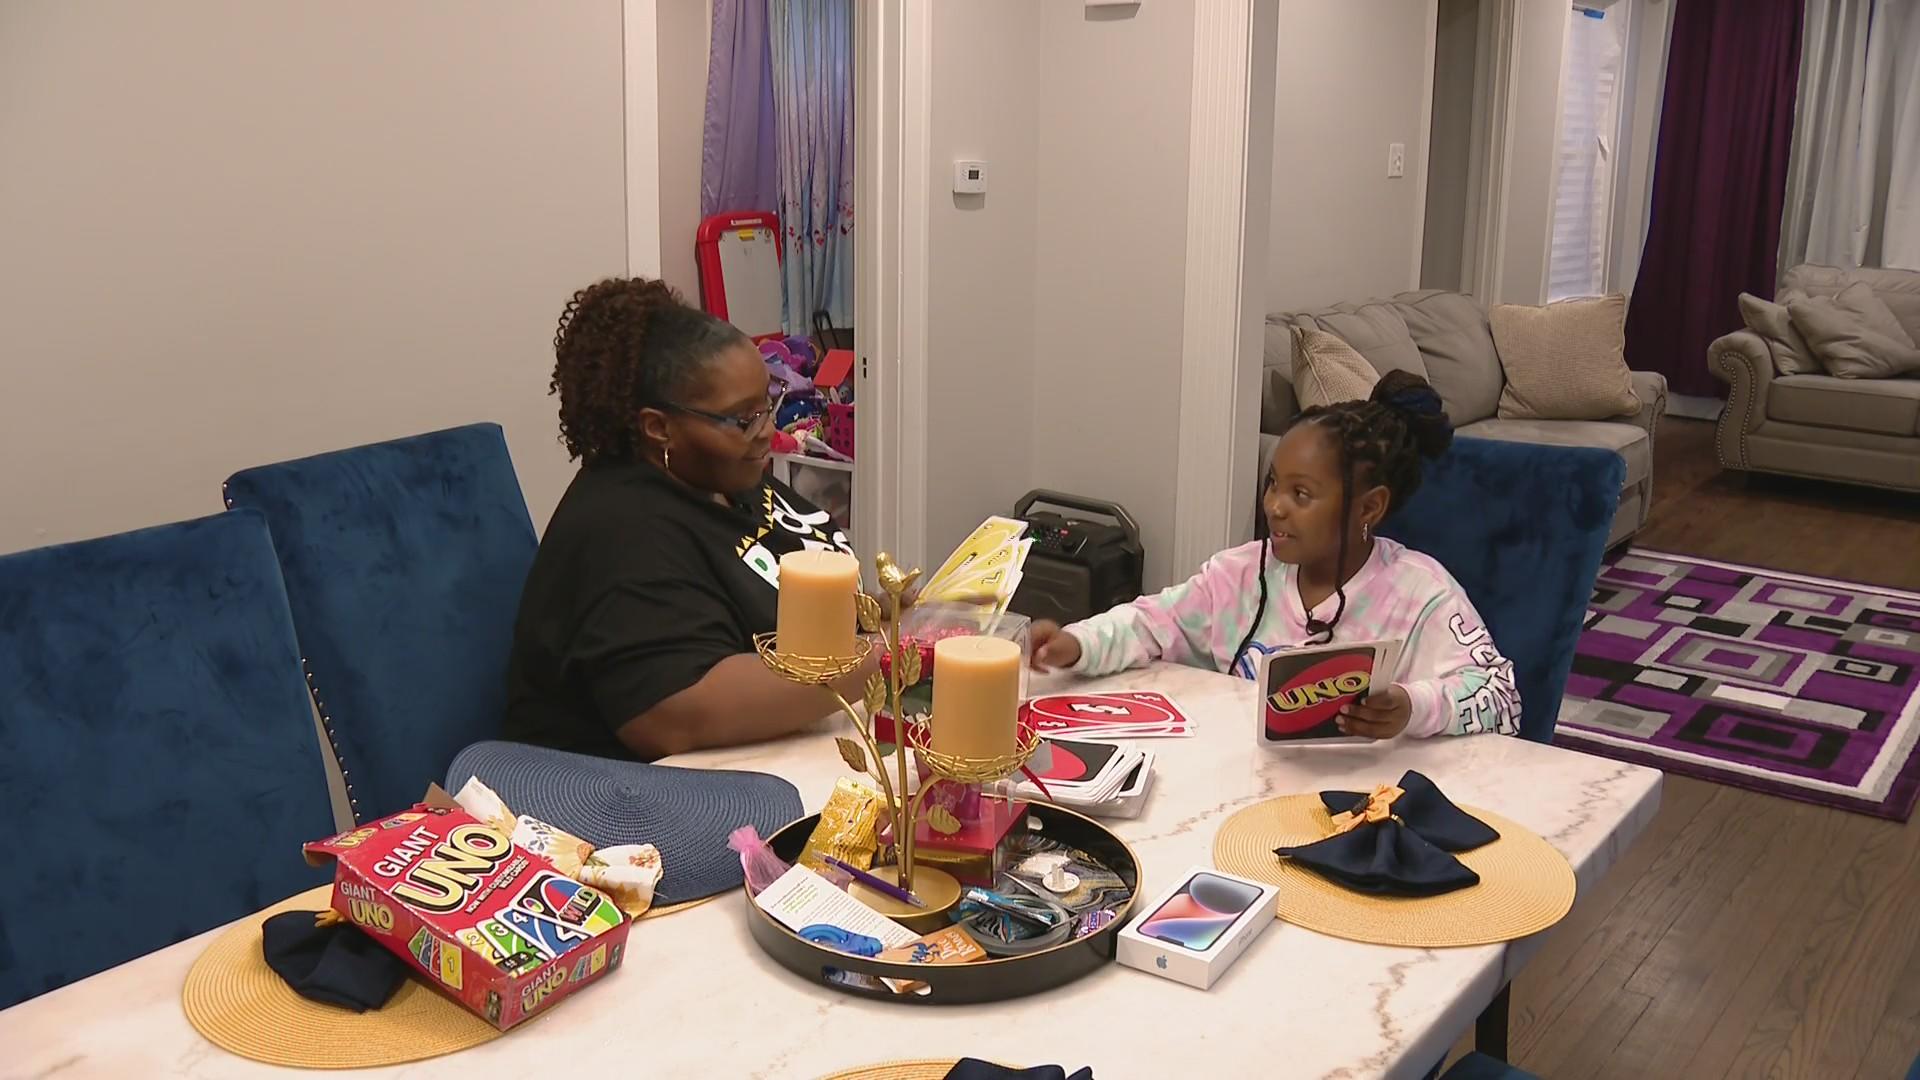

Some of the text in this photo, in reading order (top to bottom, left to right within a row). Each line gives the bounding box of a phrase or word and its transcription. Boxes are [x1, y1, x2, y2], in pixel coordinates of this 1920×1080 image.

[1266, 671, 1372, 714] UNO
[373, 824, 441, 878] GIANT
[389, 823, 513, 915] UNO
[340, 881, 378, 902] GIANT
[559, 886, 602, 926] WILD
[348, 897, 395, 931] UNO
[490, 923, 509, 937] 3
[512, 910, 529, 924] 4
[466, 933, 486, 947] 2
[447, 956, 455, 973] 1
[521, 962, 558, 998] GIANT
[521, 965, 568, 1015] UNO
